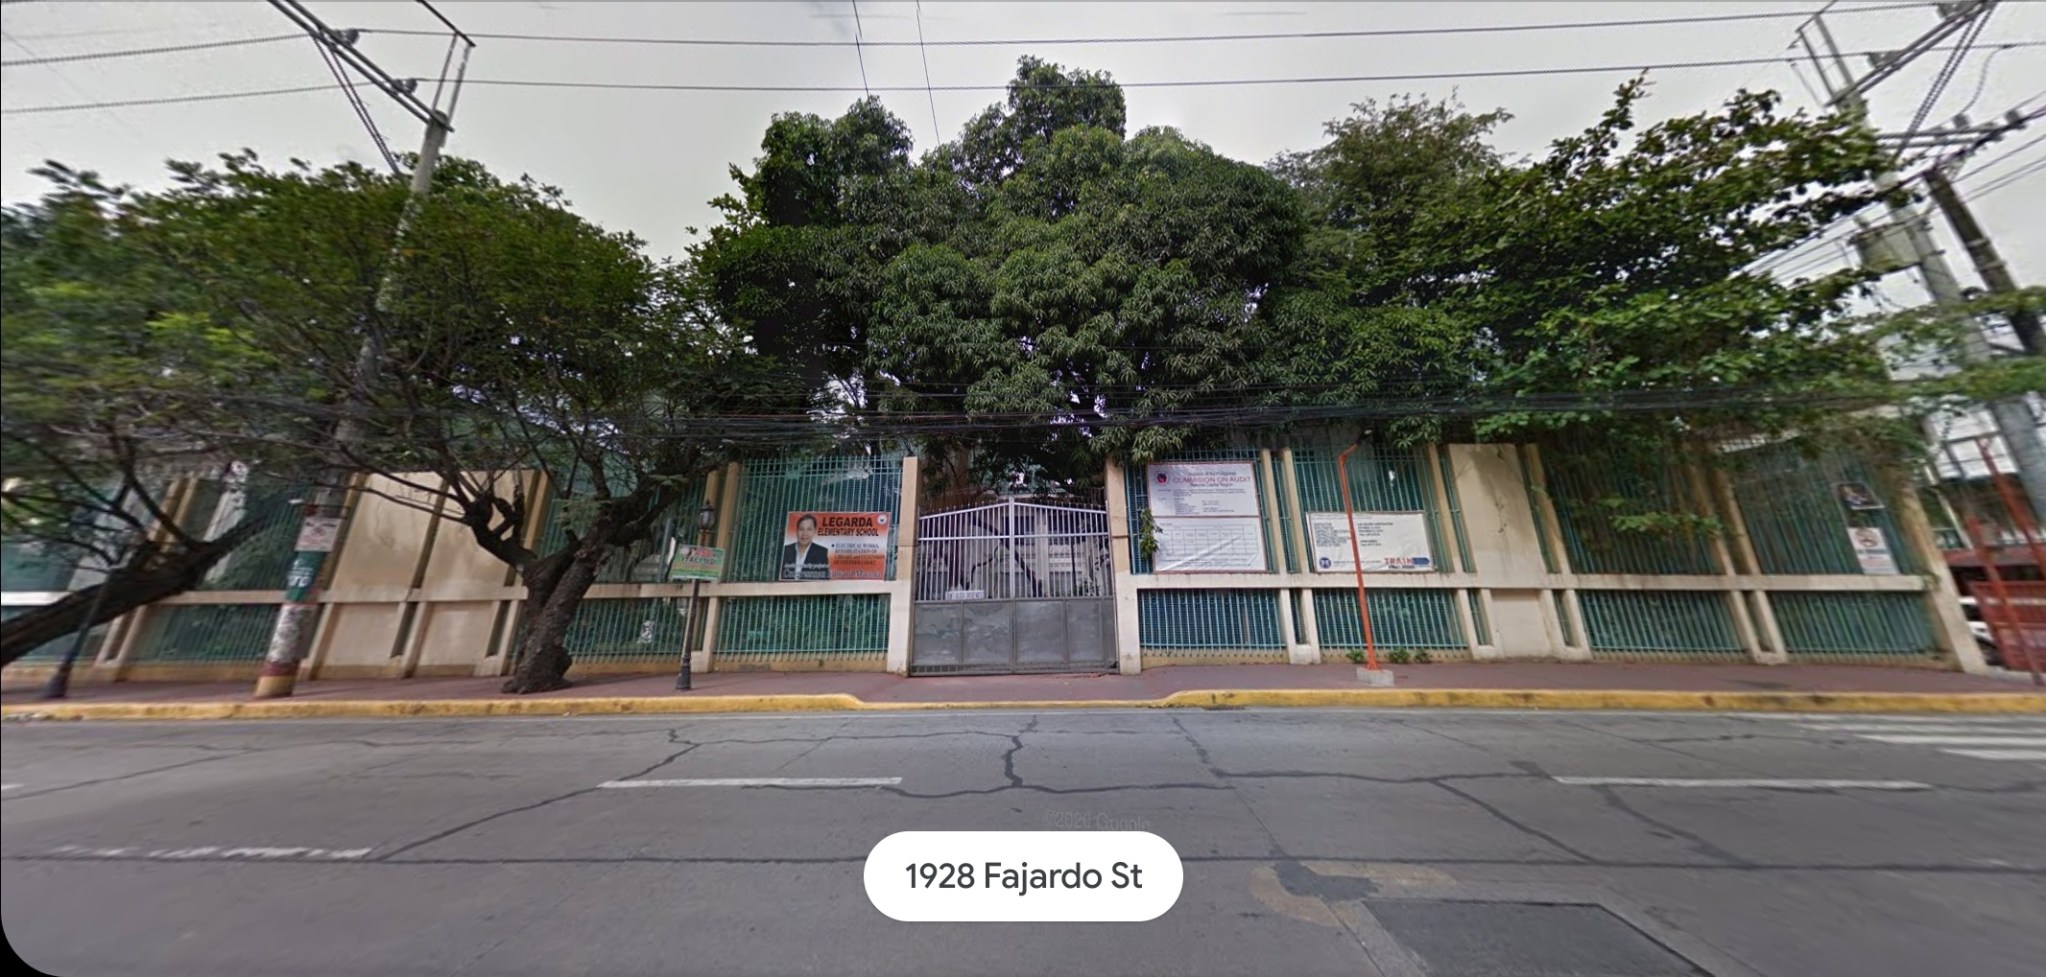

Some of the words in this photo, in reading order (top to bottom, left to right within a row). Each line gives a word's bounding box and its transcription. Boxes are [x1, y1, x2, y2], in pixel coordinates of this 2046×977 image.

[822, 517, 873, 527] LEGARDA
[817, 528, 855, 536] ELEMENTARY
[856, 528, 879, 536] SCHOOL
